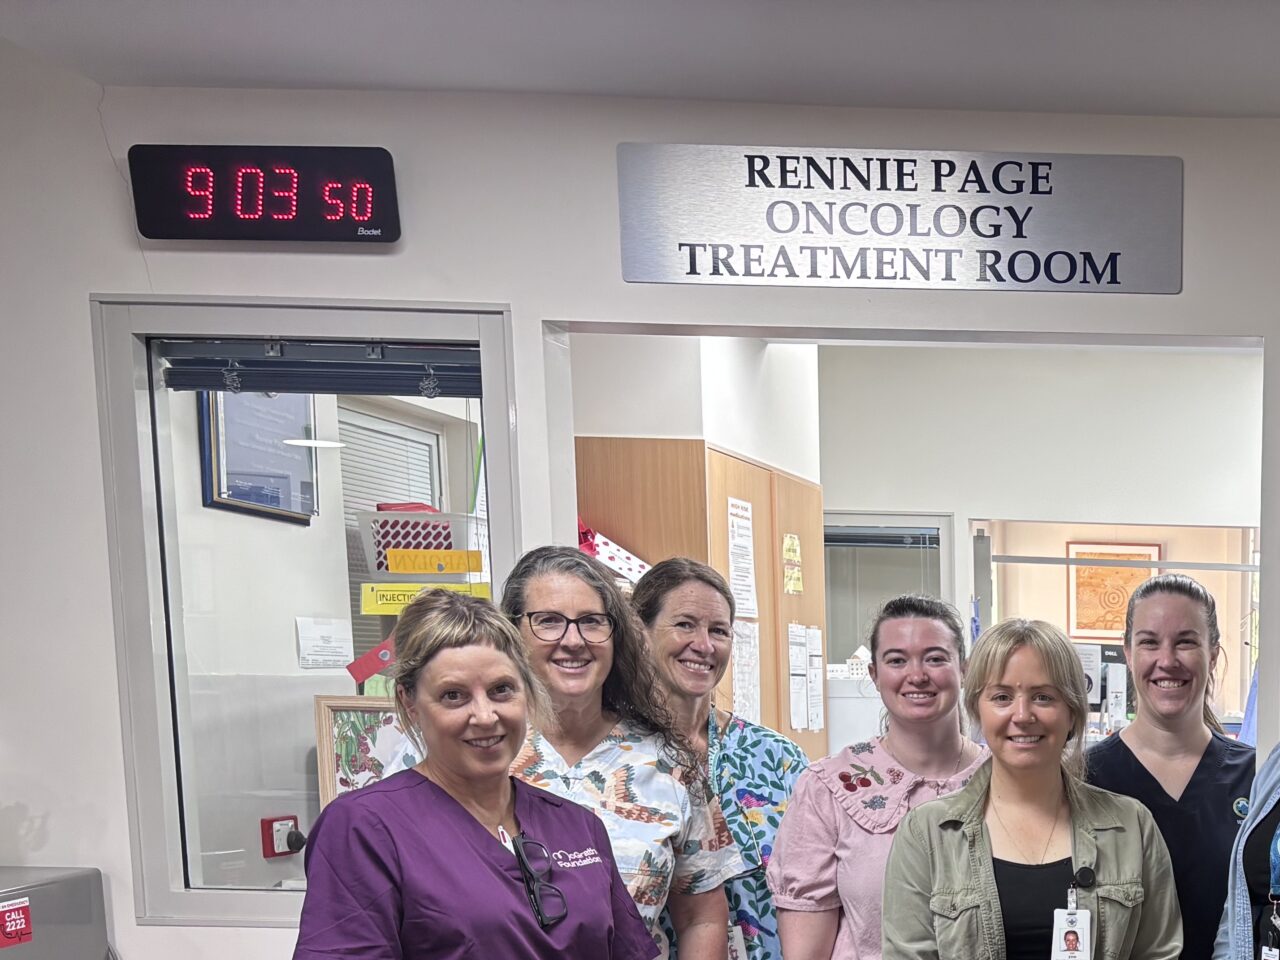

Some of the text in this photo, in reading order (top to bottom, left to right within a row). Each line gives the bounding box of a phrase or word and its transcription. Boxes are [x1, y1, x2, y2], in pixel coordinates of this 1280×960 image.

[743, 154, 1055, 195] RENNIE PAGE
[186, 166, 374, 222] 9 03 50
[765, 200, 1034, 240] ONCOLOGY
[357, 227, 382, 236] Bodet
[677, 243, 1122, 286] TREATMENT ROOM
[552, 847, 598, 861] McGrath
[557, 856, 602, 868] Foundation
[5, 909, 25, 921] CALL
[6, 918, 26, 932] 2222
